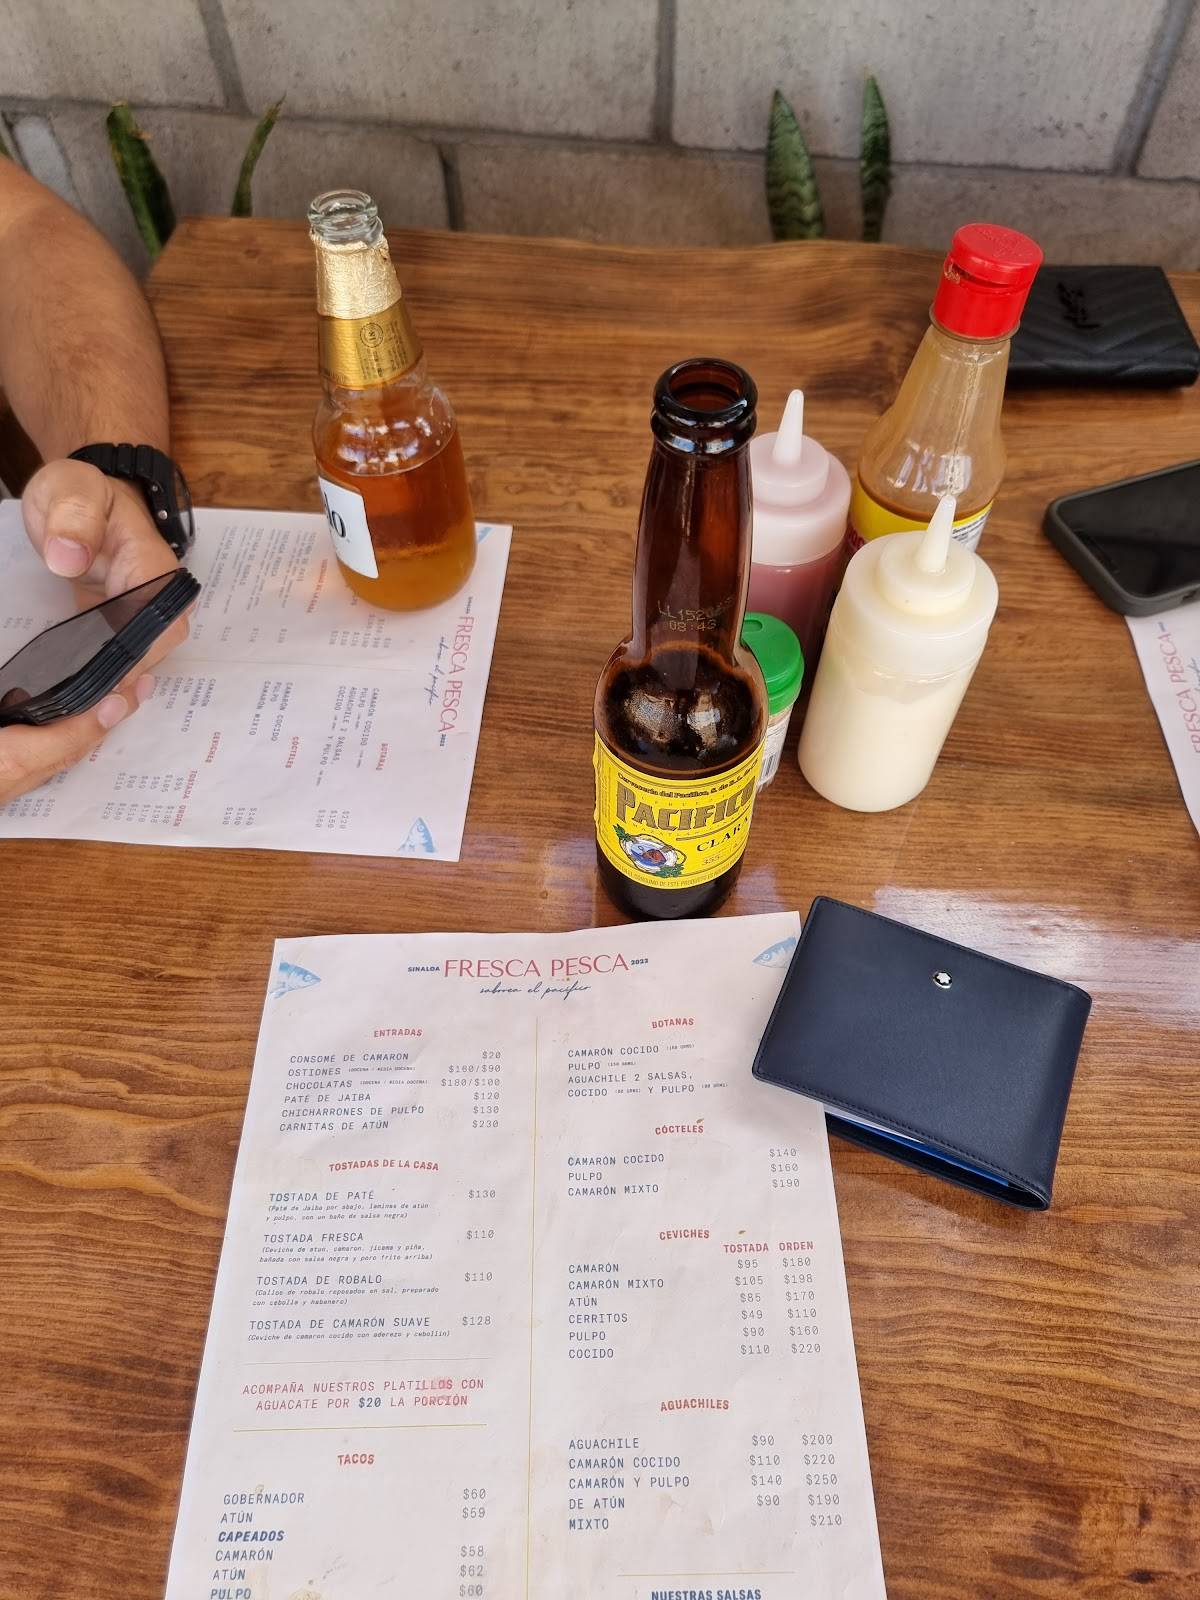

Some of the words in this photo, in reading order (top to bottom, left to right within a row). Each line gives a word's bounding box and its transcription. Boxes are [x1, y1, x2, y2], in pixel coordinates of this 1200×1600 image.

[449, 616, 475, 675] FRESCA
[1158, 632, 1188, 684] PESCA
[438, 680, 463, 734] PESCA
[445, 959, 540, 977] FRESCA
[552, 954, 629, 977] PESCA
[527, 982, 542, 993] el
[652, 1018, 693, 1028] BOTANAS
[374, 1029, 422, 1037] ENTRADAS
[482, 1051, 501, 1059] $20
[621, 1046, 658, 1055] COCIDO
[288, 1068, 340, 1076] OSTIONES
[569, 1062, 600, 1070] PULPO
[568, 1074, 626, 1083] AGUACHILE
[648, 1071, 693, 1080] SALSAS,
[286, 1080, 352, 1089] CHOCOLATAS
[568, 1089, 607, 1097] COCIDO
[662, 1085, 694, 1093] PULPO
[474, 1092, 499, 1100] $120
[282, 1108, 362, 1117] CHICHARRONES
[391, 1105, 424, 1114] PULPO
[473, 1106, 499, 1114] $130
[280, 1123, 333, 1131] CARNITAS
[342, 1122, 354, 1130] DE
[362, 1120, 388, 1129] ATÚN
[473, 1120, 498, 1128] $230
[655, 1122, 703, 1135] CÓCTELES
[568, 1156, 616, 1166] CAMARÓN
[624, 1154, 664, 1164] COCIDO
[770, 1148, 796, 1158] $140
[329, 1160, 379, 1172] TOSTADAS
[383, 1159, 395, 1167] DE
[399, 1160, 410, 1168] LA
[414, 1161, 438, 1170] CASA
[569, 1172, 602, 1180] PULPO
[771, 1163, 798, 1172] $160
[568, 1185, 616, 1196] CAMARÓN
[625, 1185, 658, 1193] MIXTO
[773, 1179, 799, 1188] $190
[270, 1193, 317, 1201] TOSTADA
[326, 1192, 338, 1200] DE
[348, 1190, 373, 1200] PATÉ
[469, 1190, 495, 1198] $130
[264, 1234, 312, 1243] TOSTADA
[322, 1233, 363, 1242] FRESCA
[467, 1230, 494, 1240] $110
[660, 1229, 709, 1240] CEVICHES
[723, 1243, 768, 1253] TOSTADA
[779, 1241, 813, 1251] ORDEN
[569, 1263, 618, 1273] CAMARÓN
[738, 1259, 757, 1269] $95
[783, 1257, 810, 1267] $180
[257, 1276, 307, 1285] TOSTADA
[316, 1276, 330, 1284] DE
[339, 1275, 381, 1284] ROBALO
[465, 1272, 492, 1282] $110
[569, 1279, 619, 1289] CAMARÓN
[628, 1279, 663, 1288] MIXTO
[735, 1276, 763, 1286] $105
[784, 1274, 812, 1286] $198
[569, 1295, 597, 1306] ATÚN
[740, 1293, 760, 1303] $85
[786, 1291, 814, 1301] $170
[569, 1313, 627, 1323] CERRITOS
[742, 1310, 762, 1320] $49
[788, 1308, 816, 1318] $110
[250, 1320, 301, 1330] TOSTADA
[310, 1320, 324, 1328] DE
[334, 1317, 384, 1328] CAMARÓN
[394, 1318, 429, 1326] SUAVE
[462, 1316, 490, 1326] $128
[569, 1331, 605, 1341] PULPO
[743, 1327, 764, 1337] $90
[790, 1326, 818, 1336] $160
[569, 1349, 613, 1358] COCIDO
[741, 1345, 769, 1355] $110
[792, 1344, 820, 1353] $220
[243, 1382, 303, 1394] ACOMPAÑA
[314, 1382, 374, 1392] NUESTROS
[384, 1379, 452, 1390] PLATILLOS
[462, 1379, 483, 1389] CON
[256, 1399, 318, 1410] AGUACATE
[328, 1399, 349, 1408] POR
[359, 1397, 381, 1408] $20
[391, 1398, 404, 1407] LA
[415, 1393, 467, 1406] PORCIÓN
[661, 1399, 729, 1411] AGUACHILES
[569, 1438, 638, 1449] AGUACHILE
[752, 1435, 774, 1446] $90
[802, 1433, 832, 1446] $200
[338, 1454, 374, 1465] TACOS
[569, 1456, 623, 1469] CAMARÓN
[634, 1457, 680, 1468] COCIDO
[750, 1455, 780, 1466] $110
[804, 1454, 834, 1465] $220
[569, 1476, 624, 1489] CAMARÓN
[634, 1477, 640, 1487] Y
[651, 1476, 689, 1487] PULPO
[752, 1475, 782, 1486] $140
[806, 1474, 837, 1485] $250
[224, 1492, 304, 1504] GOBERNADOR
[464, 1488, 485, 1500] $60
[569, 1499, 583, 1509] DE
[594, 1496, 624, 1509] ATÚN
[757, 1495, 779, 1506] $90
[808, 1494, 839, 1506] $190
[221, 1511, 252, 1523] ATÚN
[463, 1507, 485, 1519] $59
[570, 1518, 608, 1530] MIXTO
[811, 1514, 841, 1526] $210
[218, 1530, 284, 1542] CAPEADOS
[216, 1547, 273, 1561] CAMARÓN
[461, 1545, 483, 1557] $58
[213, 1568, 245, 1580] ATÚN
[460, 1564, 483, 1578] $62
[211, 1588, 251, 1600] PULPO
[460, 1584, 483, 1597] $60
[652, 1591, 712, 1600] NUESTRAS
[717, 1589, 761, 1600] SALSAS
